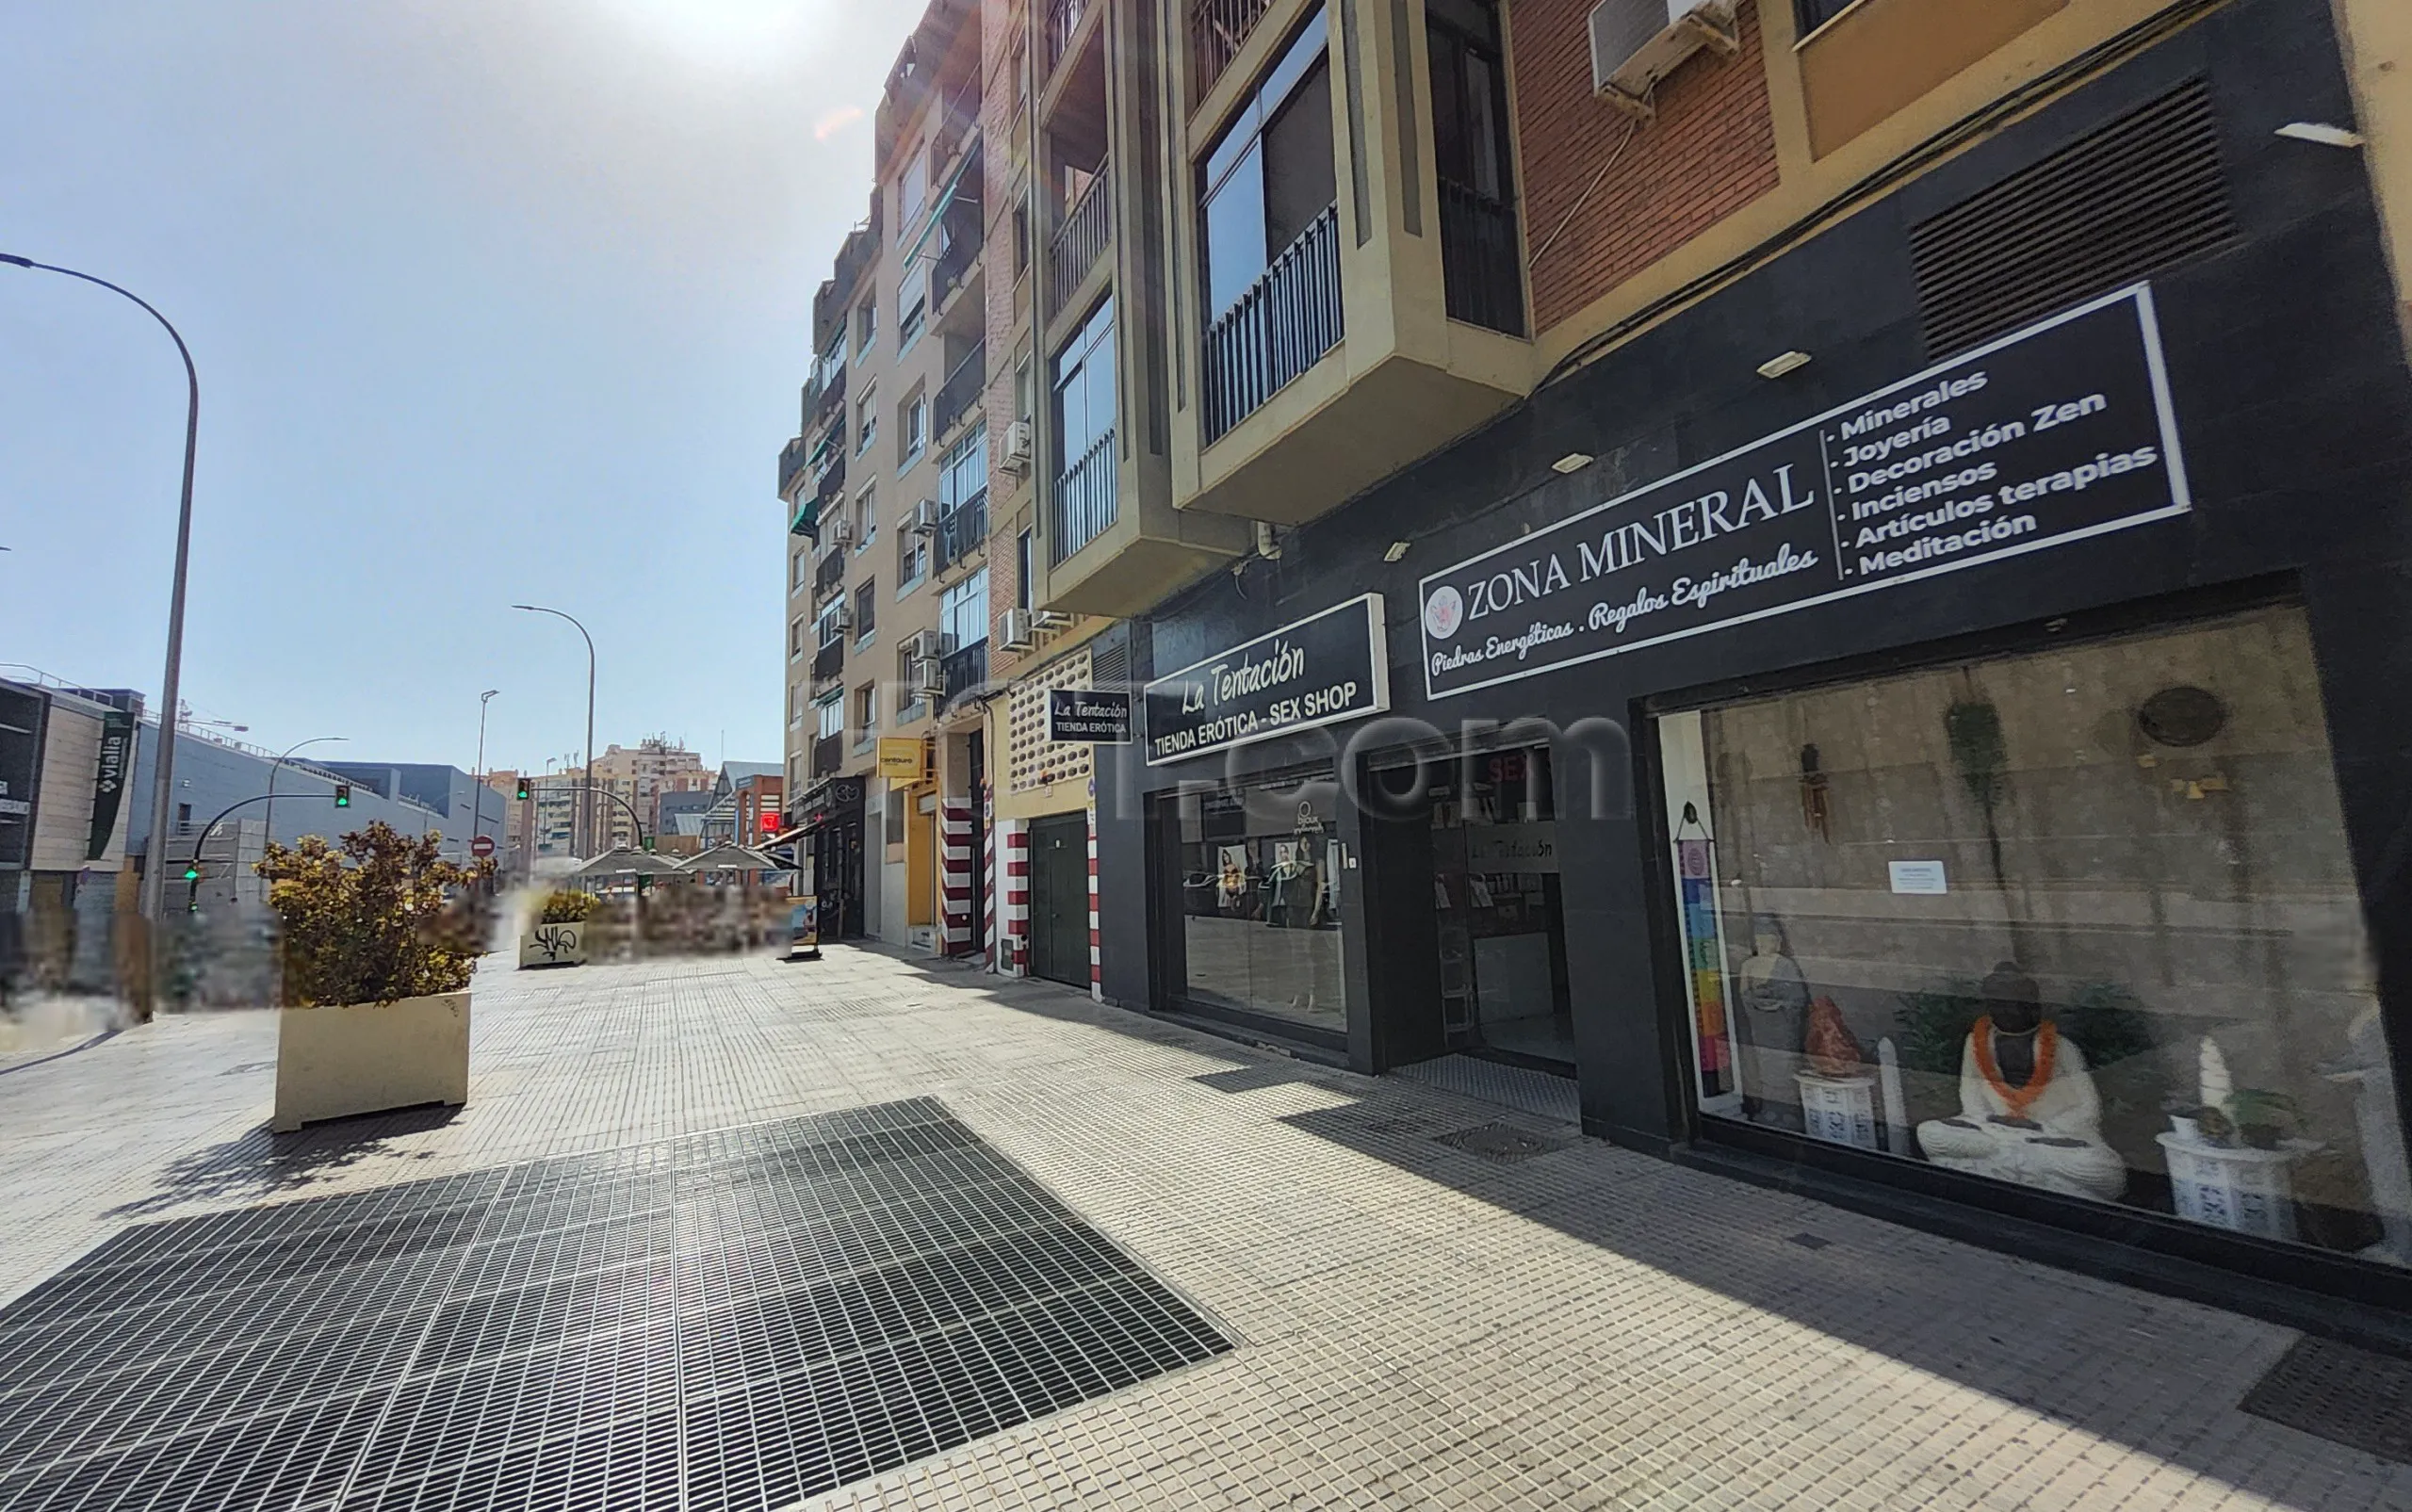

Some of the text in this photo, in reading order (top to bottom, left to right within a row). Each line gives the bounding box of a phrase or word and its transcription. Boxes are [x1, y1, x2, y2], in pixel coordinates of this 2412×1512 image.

[1841, 371, 1988, 441] Minerales
[1843, 415, 1950, 467] Joyería
[1849, 393, 2108, 494] Decoración Zen
[1852, 462, 1997, 520] Inciensos
[1855, 447, 2158, 548] Artículos terapias
[1467, 463, 1814, 621] ZONA MINERAL
[1859, 514, 2037, 575] Meditación
[1431, 647, 1484, 676] Piedras
[1486, 623, 1574, 660] Energéticas
[1589, 587, 1669, 634] Regalos
[1671, 543, 1819, 609] Espirituales
[1054, 701, 1127, 718] La Tentación
[1182, 639, 1304, 714] La Tentación
[1055, 721, 1126, 733] TIENDA ERÓTICA
[1155, 730, 1196, 756] TIENDA
[1198, 711, 1258, 742] ERÓTICA
[1269, 698, 1301, 725] SEX
[1304, 682, 1358, 714] SHOP
[101, 736, 122, 779] vialia
